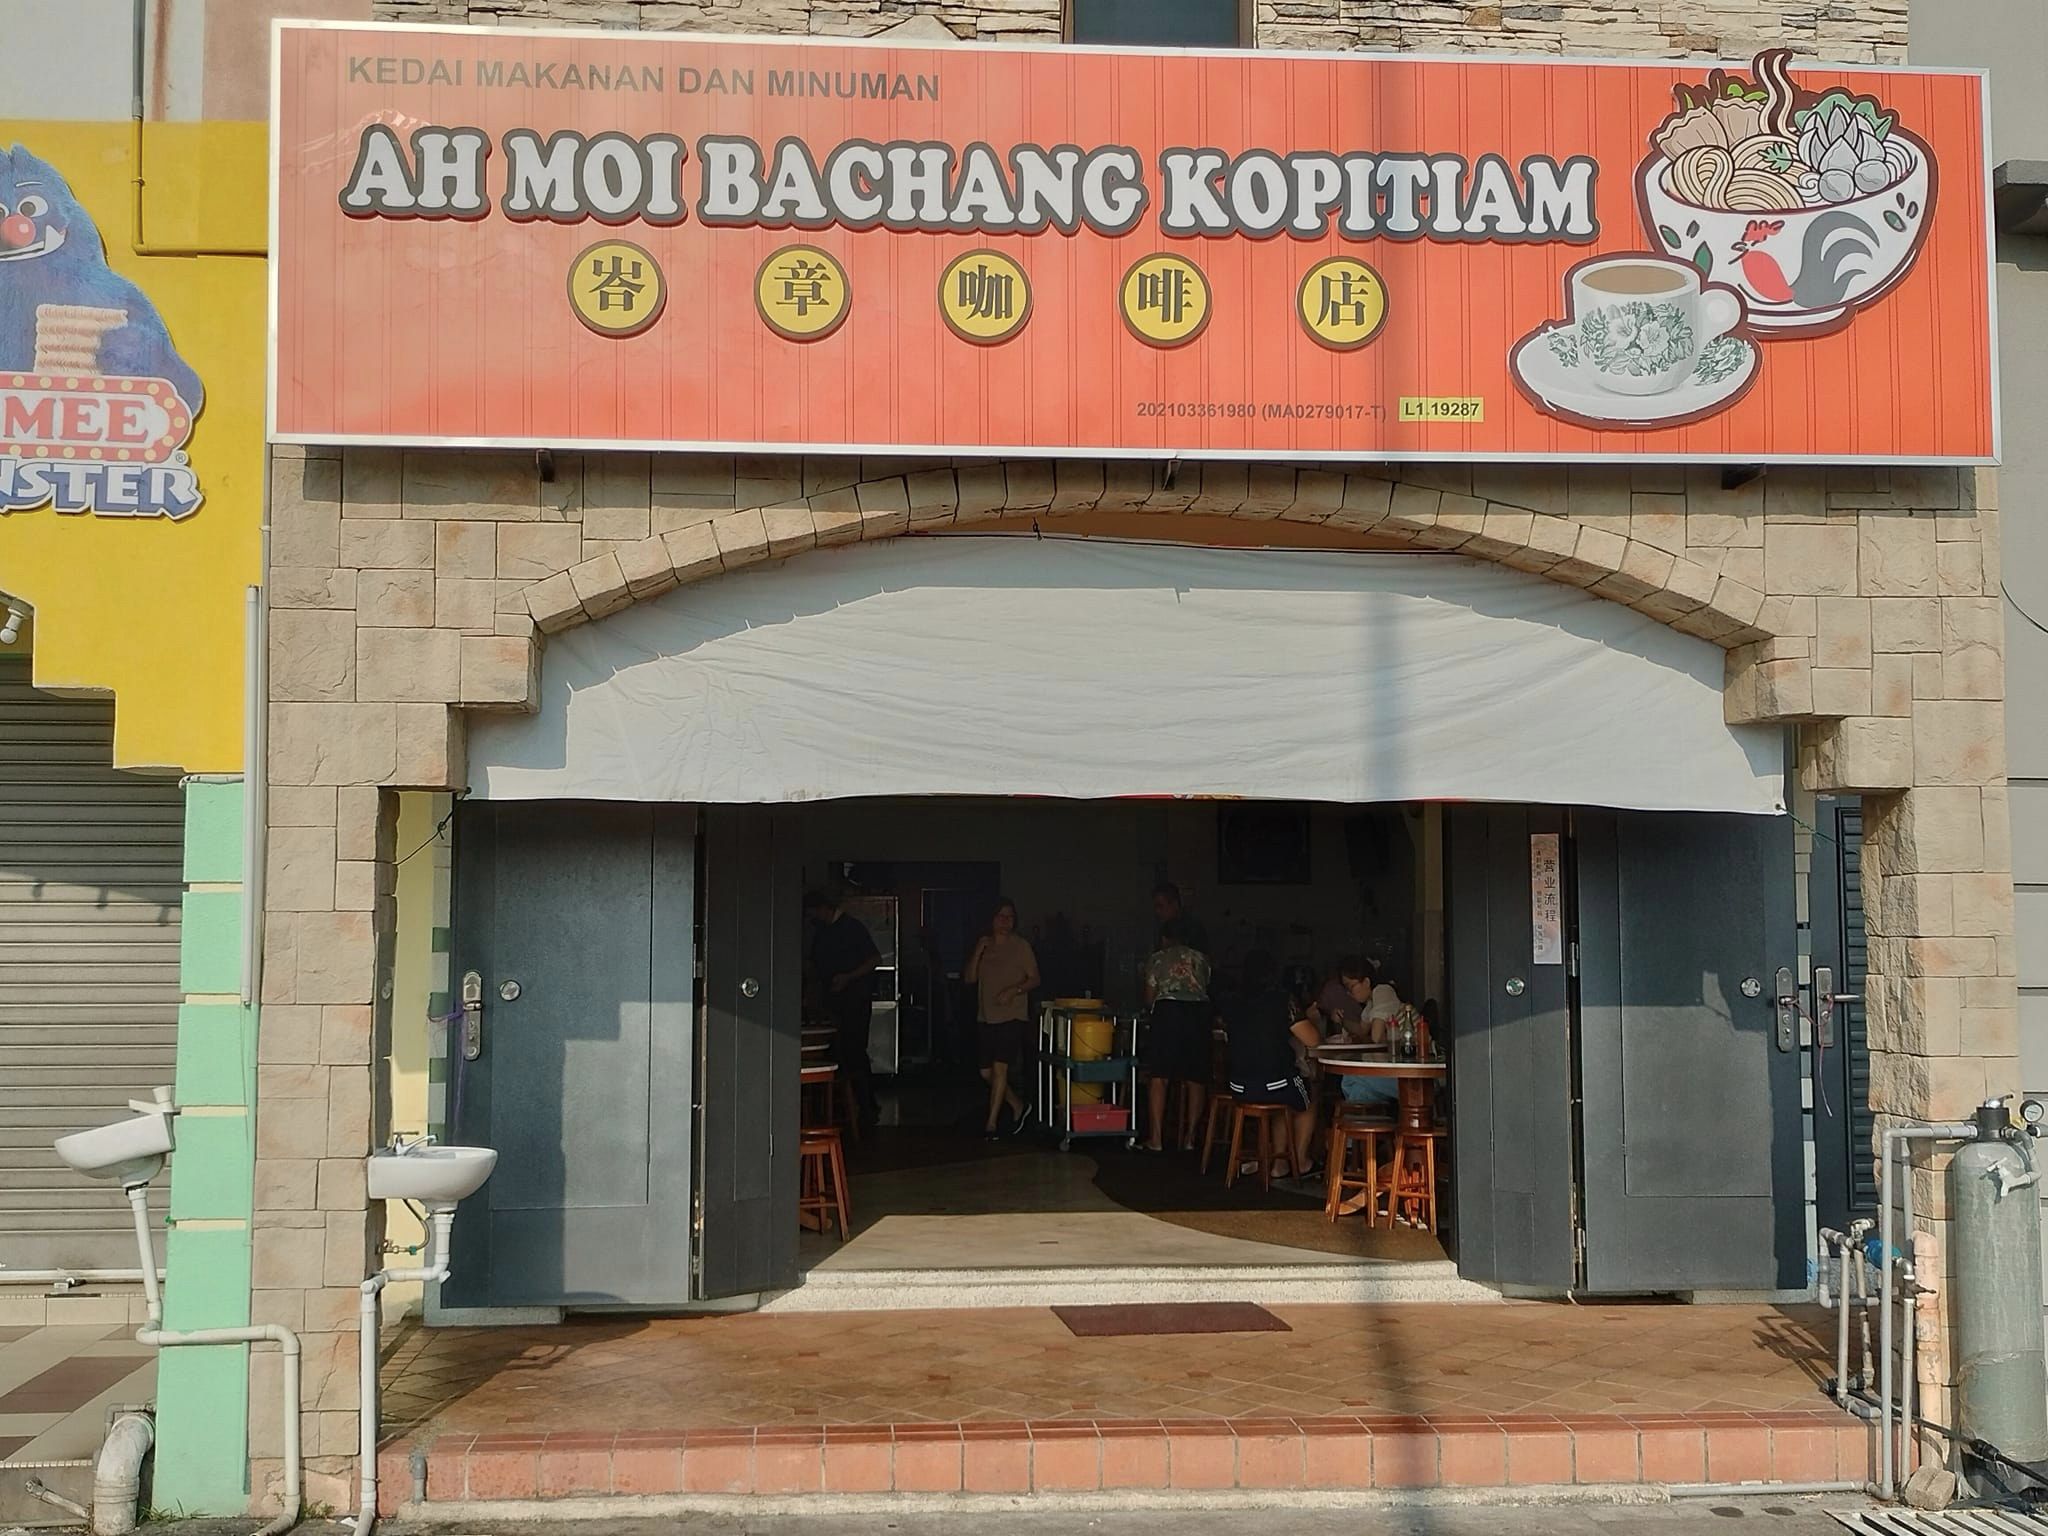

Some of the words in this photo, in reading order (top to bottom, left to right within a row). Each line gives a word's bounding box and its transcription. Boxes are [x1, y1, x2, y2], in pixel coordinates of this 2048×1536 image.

[349, 56, 463, 86] KEDAI
[476, 60, 664, 93] MAKANAN
[678, 67, 755, 95] DAN
[768, 70, 939, 102] MINUMAN
[342, 127, 488, 214] AH
[504, 131, 686, 221] MOI
[700, 137, 1146, 233] BACHANG
[1161, 150, 1598, 239] KOPITIAM
[588, 255, 1367, 328] 峇章咖啡店
[4, 396, 148, 442] MEE
[1136, 402, 1257, 418] 202103361980
[1261, 402, 1388, 422] (MA0279017-T)
[1404, 401, 1481, 417] L1.19287
[1543, 859, 1556, 922] 营业流程
